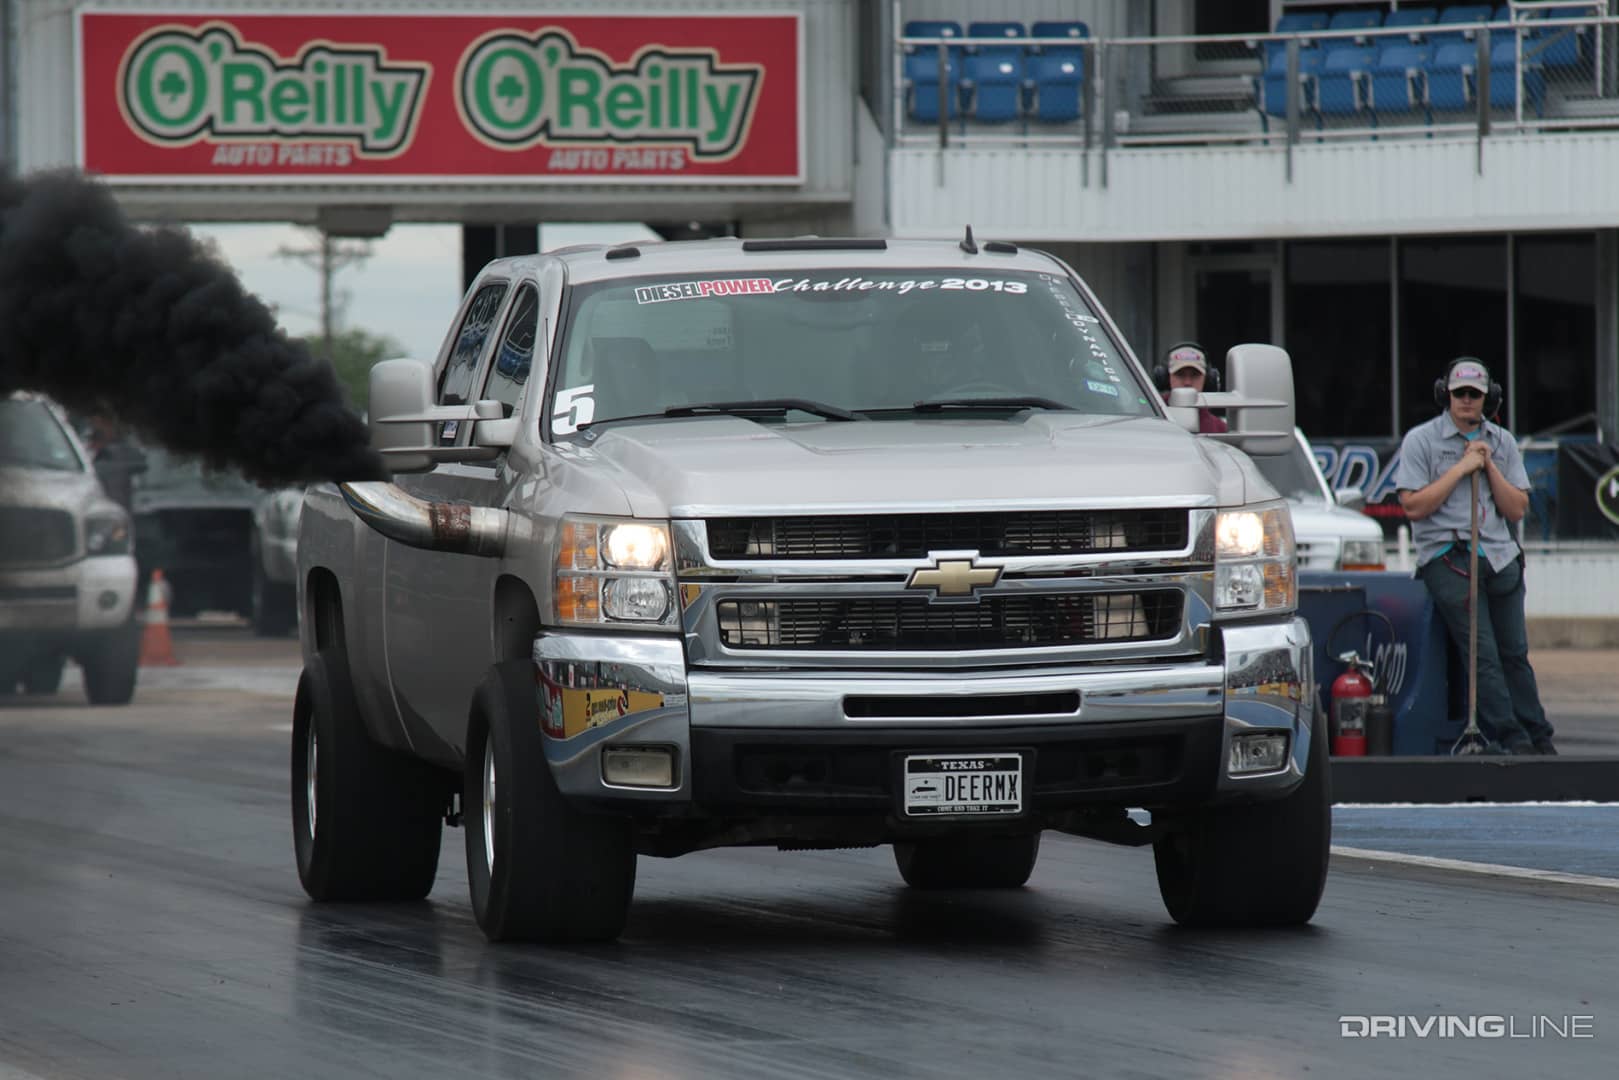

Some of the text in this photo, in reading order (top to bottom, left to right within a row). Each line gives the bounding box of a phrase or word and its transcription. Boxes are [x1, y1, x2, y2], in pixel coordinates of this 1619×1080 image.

[136, 41, 409, 141] O'Reilly
[474, 46, 742, 143] O'Reilly
[211, 145, 352, 167] AUTO PARTS
[548, 149, 685, 171] AUTO PARTS
[774, 277, 939, 294] Challenge
[940, 278, 1028, 294] 2013
[551, 384, 595, 435] 5
[941, 760, 985, 770] TEXAS
[945, 774, 1018, 801] DEERMX
